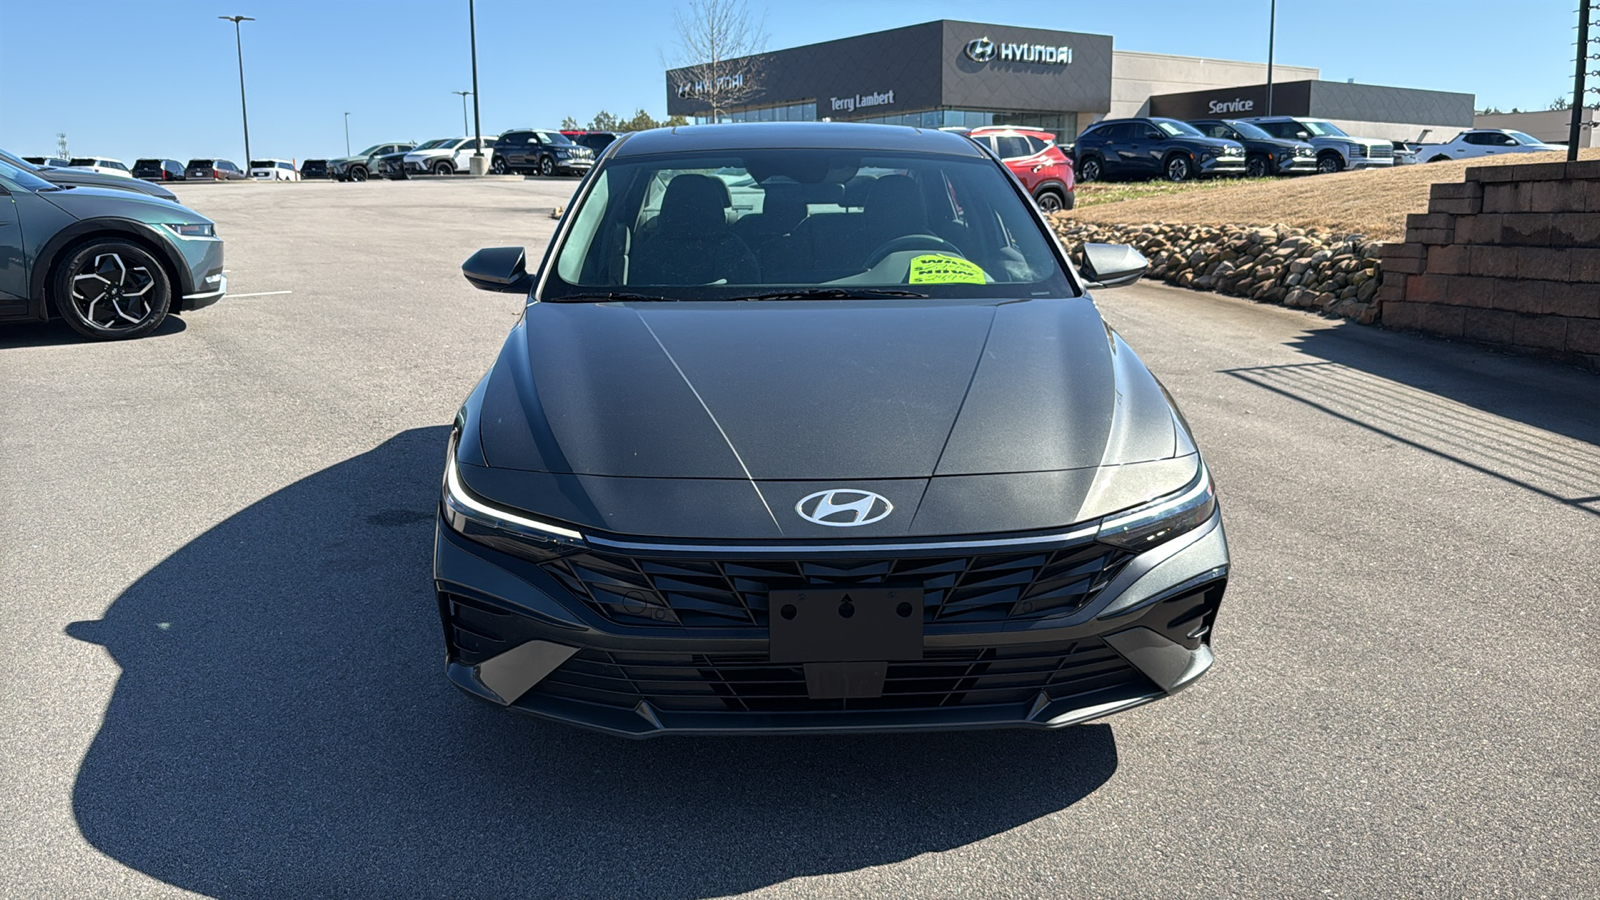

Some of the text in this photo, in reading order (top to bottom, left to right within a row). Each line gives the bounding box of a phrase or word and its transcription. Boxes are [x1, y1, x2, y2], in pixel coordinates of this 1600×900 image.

[1001, 43, 1072, 64] HYUNDAI
[830, 89, 894, 112] Terry Lambert
[1208, 98, 1254, 114] Service
